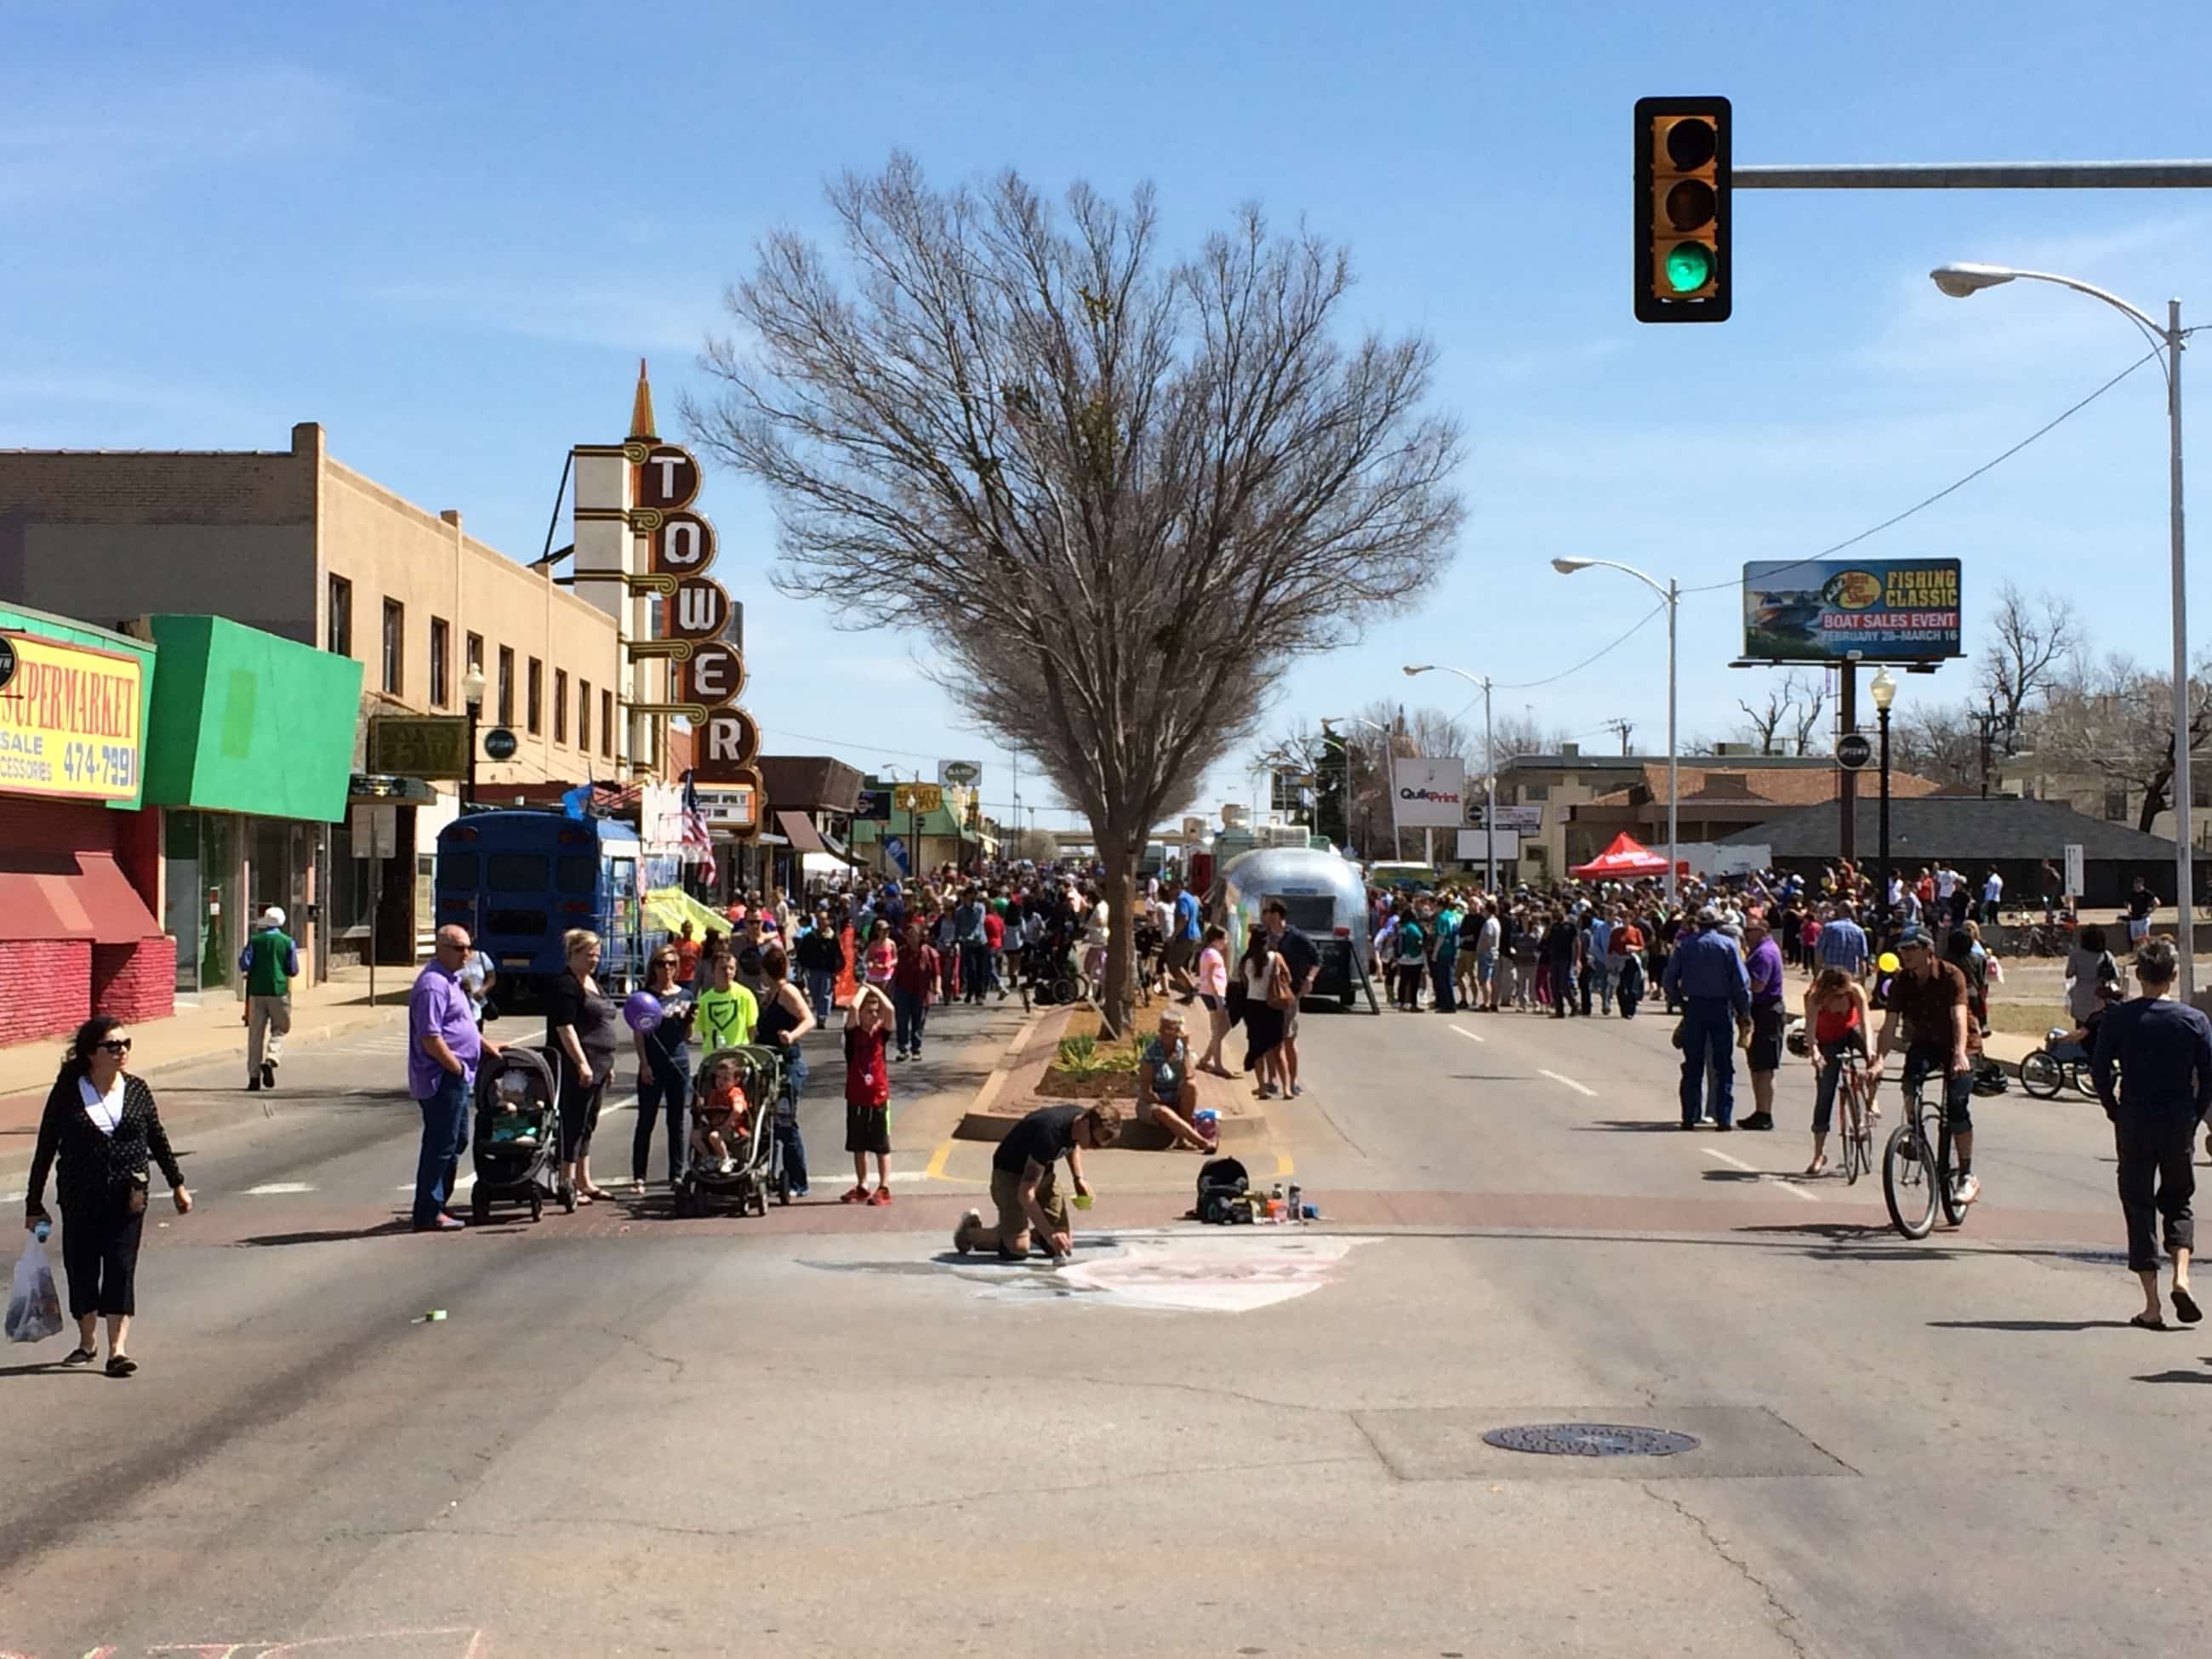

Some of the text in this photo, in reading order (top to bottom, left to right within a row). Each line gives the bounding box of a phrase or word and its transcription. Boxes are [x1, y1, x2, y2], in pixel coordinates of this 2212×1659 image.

[1887, 569, 1956, 589] FISHING
[1885, 589, 1957, 607] CLASSIC
[650, 456, 742, 761] TOWER
[1823, 613, 1956, 629] BOAT SALES EVENT
